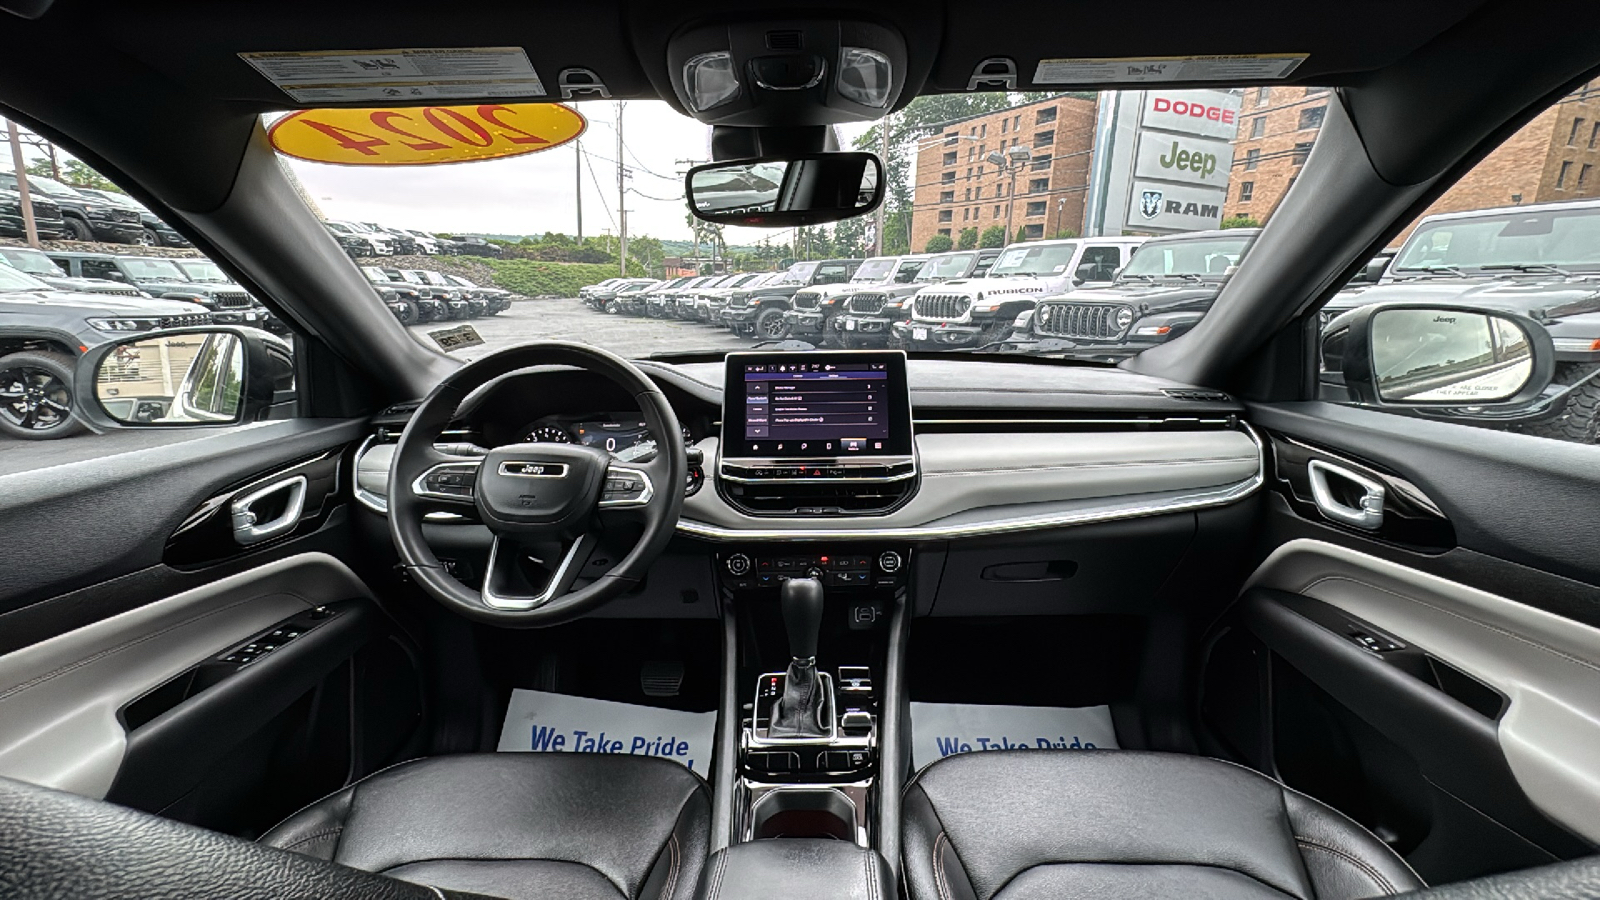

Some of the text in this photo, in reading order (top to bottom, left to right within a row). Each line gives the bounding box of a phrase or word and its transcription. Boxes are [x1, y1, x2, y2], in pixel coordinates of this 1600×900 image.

[1153, 97, 1236, 125] DODGE
[1160, 141, 1217, 179] Jeep
[1164, 199, 1219, 219] RAM
[987, 287, 1044, 297] RUBICON
[1432, 315, 1456, 324] Jeep
[521, 464, 545, 475] Jeep
[532, 725, 690, 757] We Take Pride
